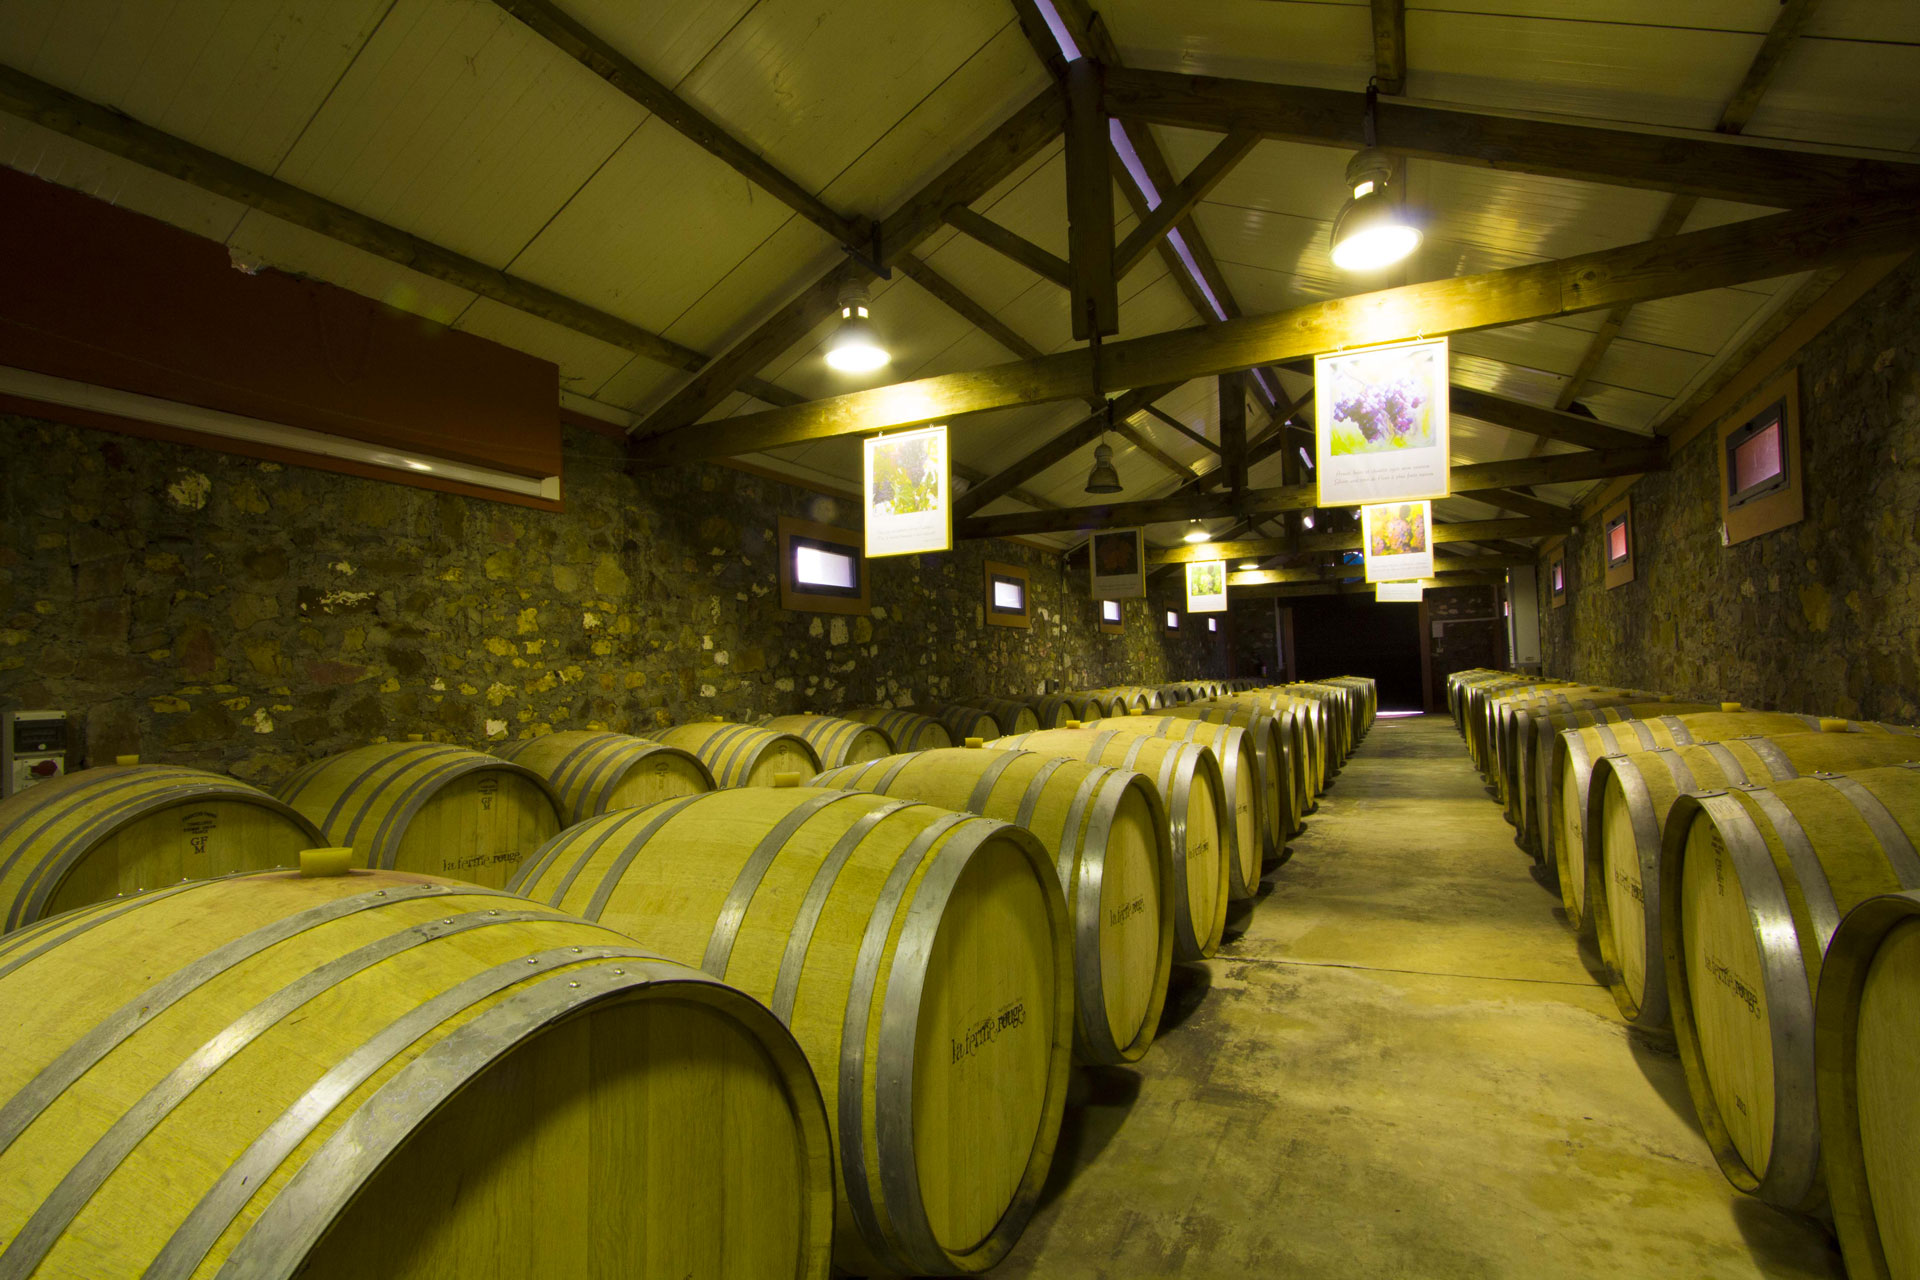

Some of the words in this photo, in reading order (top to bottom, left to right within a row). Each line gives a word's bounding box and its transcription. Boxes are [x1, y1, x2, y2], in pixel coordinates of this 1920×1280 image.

[190, 836, 209, 846] GF
[194, 845, 206, 855] M
[951, 1038, 965, 1065] la
[996, 1003, 1027, 1033] rouge
